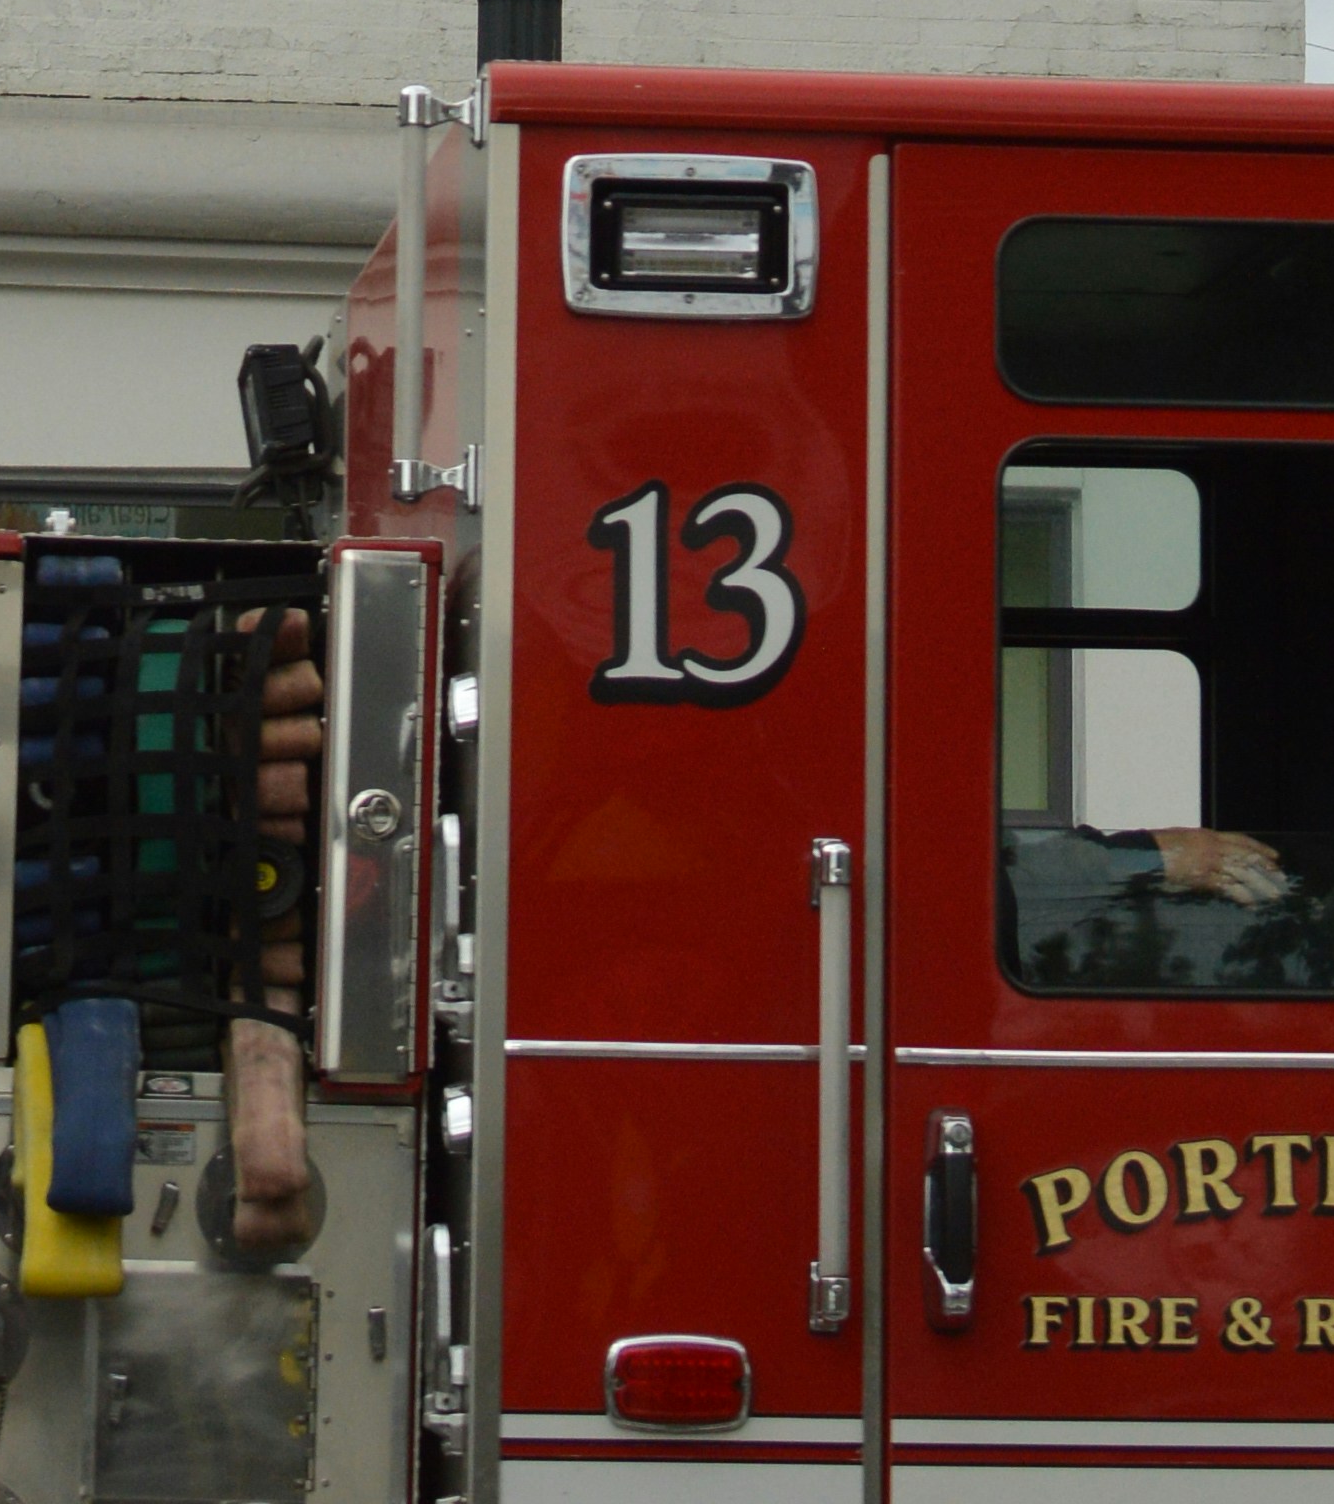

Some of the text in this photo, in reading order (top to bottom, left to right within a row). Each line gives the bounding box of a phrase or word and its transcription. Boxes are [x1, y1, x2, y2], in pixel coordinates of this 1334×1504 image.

[593, 482, 805, 702] 13
[1025, 1295, 1199, 1351] FIRE
[1225, 1296, 1276, 1351] &
